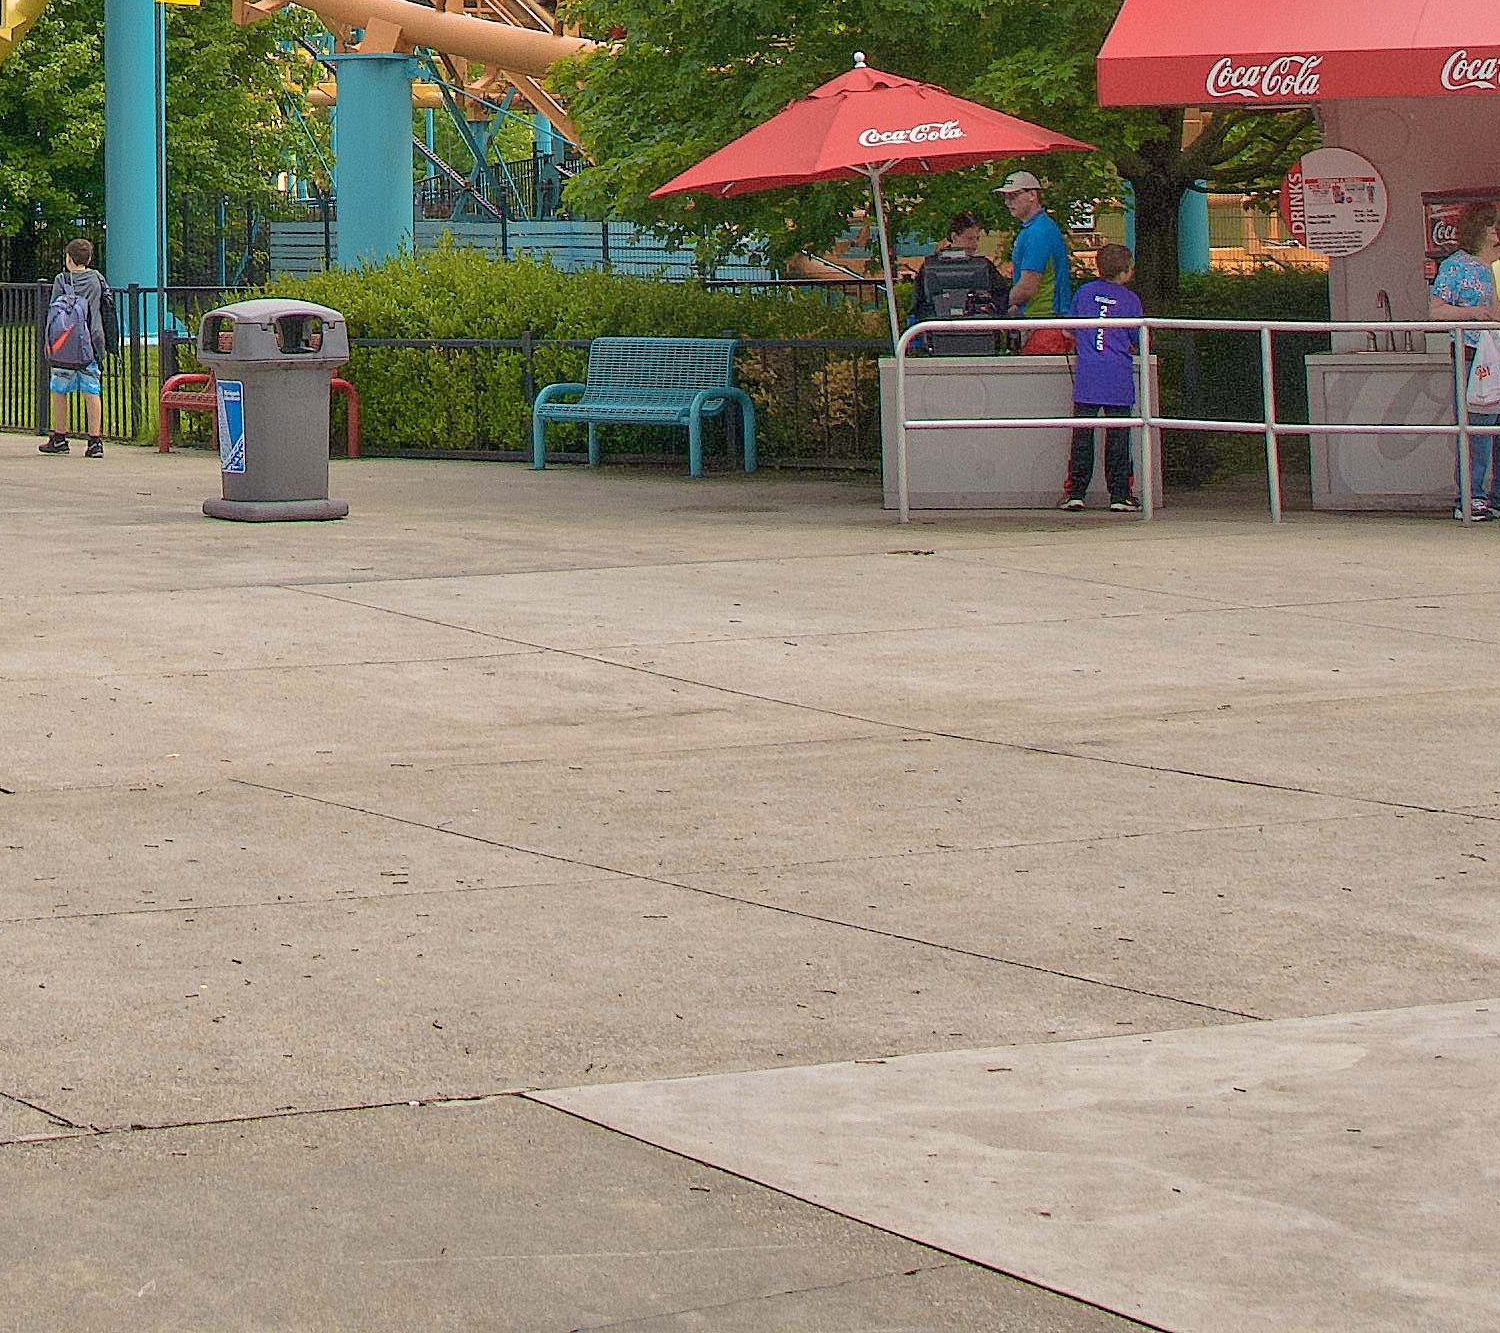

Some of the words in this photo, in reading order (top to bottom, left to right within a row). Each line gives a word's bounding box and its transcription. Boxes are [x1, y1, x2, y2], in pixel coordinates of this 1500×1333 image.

[1205, 54, 1323, 98] Coca-Cola
[858, 119, 961, 148] Coca-Cola
[1287, 172, 1306, 234] DRINKS
[1095, 304, 1109, 351] 225
